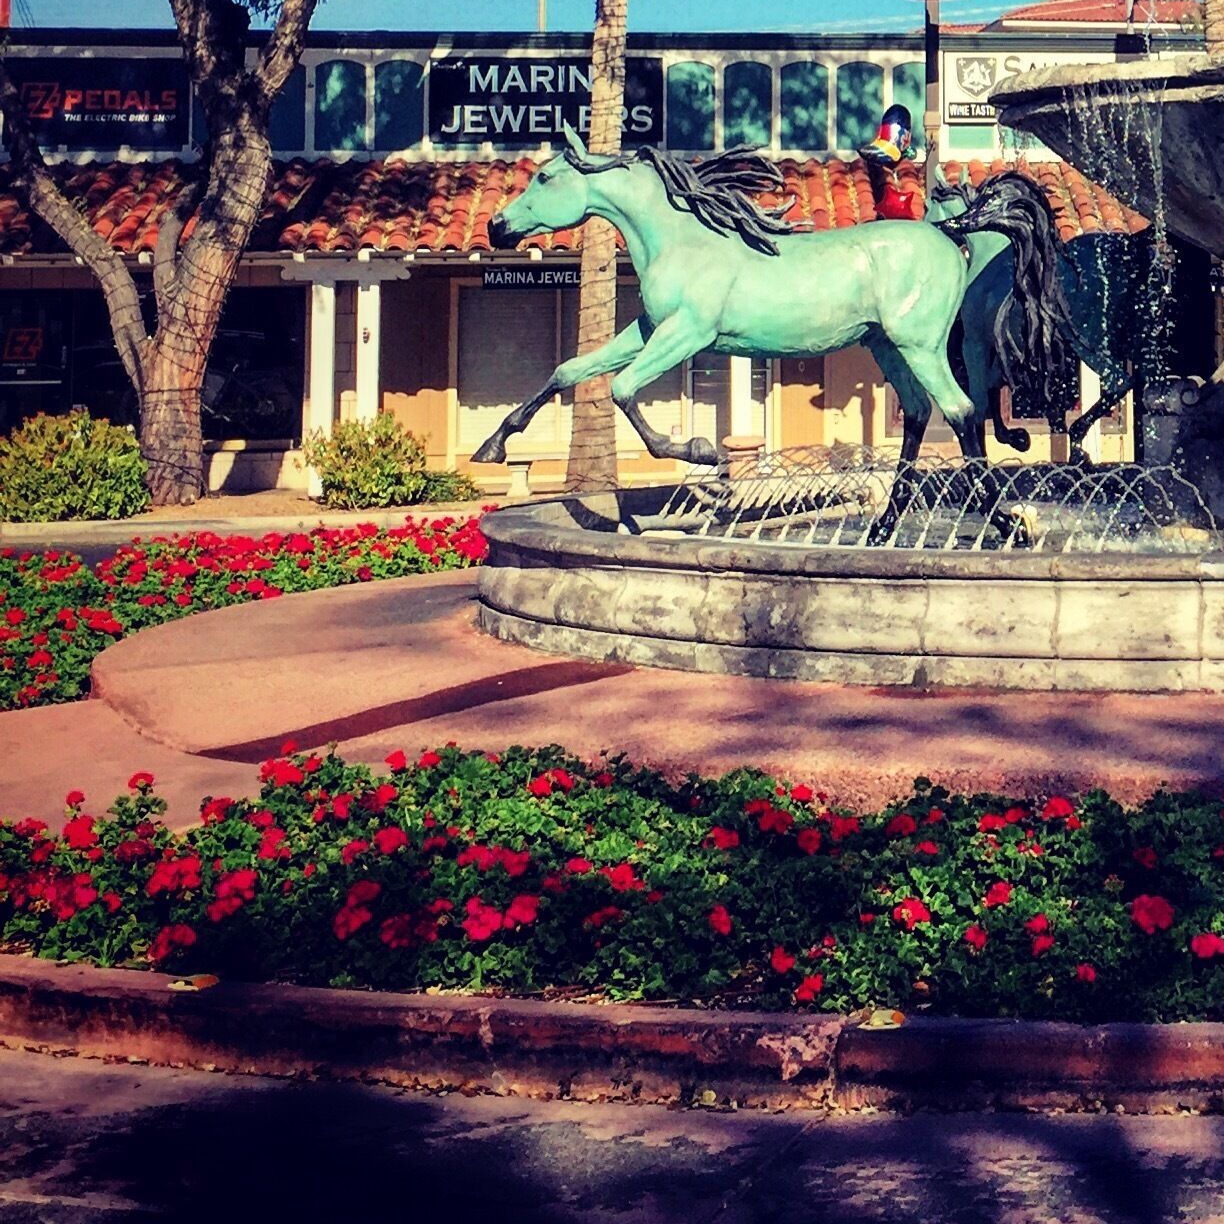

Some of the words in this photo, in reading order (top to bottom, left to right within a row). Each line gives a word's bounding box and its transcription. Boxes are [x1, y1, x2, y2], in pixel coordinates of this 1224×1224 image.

[469, 64, 593, 94] MARIN
[63, 90, 177, 111] PEDALS
[949, 104, 969, 117] WINE
[65, 113, 82, 122] THE
[84, 113, 127, 122] ELECTRIC
[128, 113, 149, 122] BIKE
[152, 113, 177, 122] SHOP
[484, 272, 535, 284] MARINA
[538, 272, 581, 284] JEWEL
